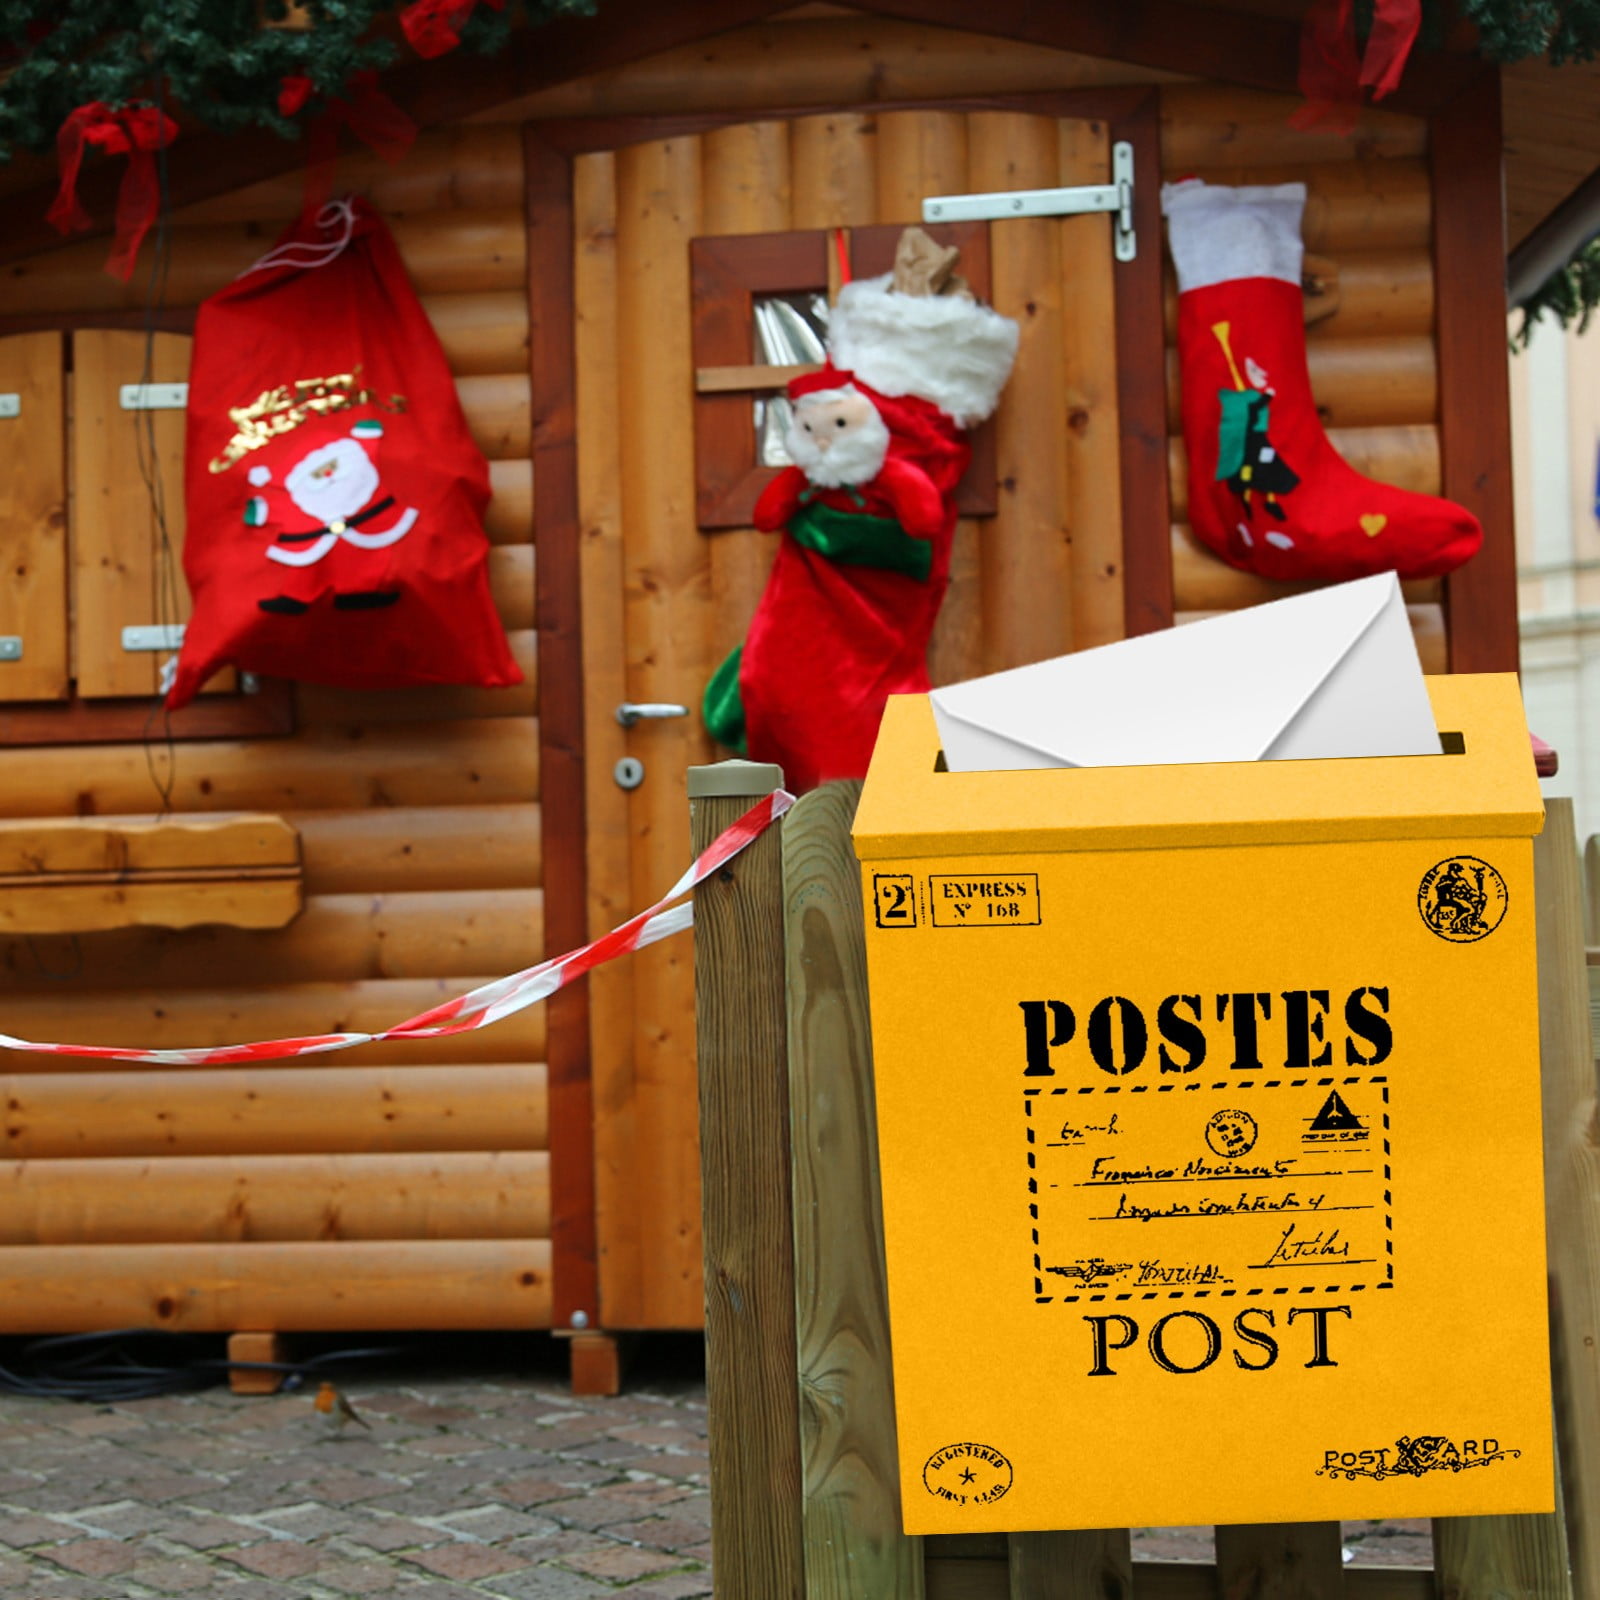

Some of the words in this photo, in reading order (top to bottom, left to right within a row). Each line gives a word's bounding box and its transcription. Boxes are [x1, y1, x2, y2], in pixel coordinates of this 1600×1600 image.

[943, 882, 1027, 898] EXPRESS
[987, 903, 1020, 917] 168
[1018, 986, 1393, 1077] POSTES
[1082, 1305, 1352, 1377] POST
[930, 1446, 1005, 1470] REGISTERED
[1325, 1449, 1391, 1470] POST
